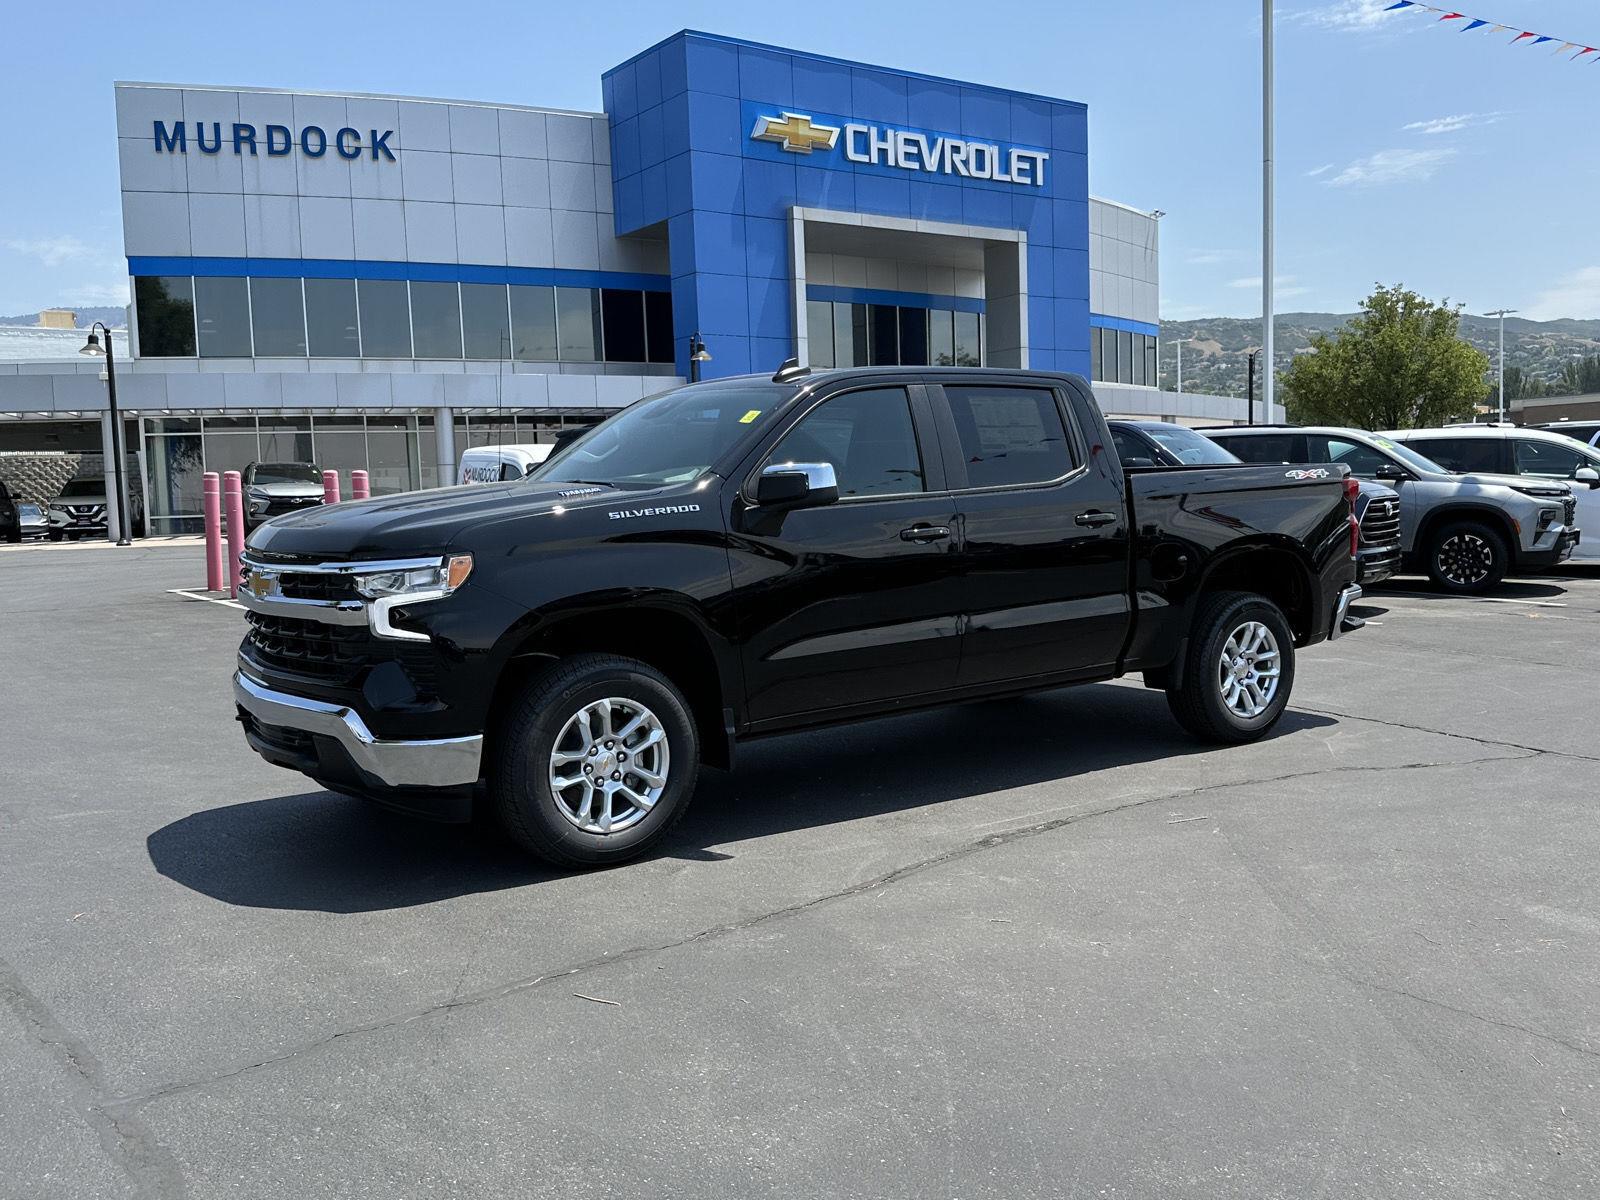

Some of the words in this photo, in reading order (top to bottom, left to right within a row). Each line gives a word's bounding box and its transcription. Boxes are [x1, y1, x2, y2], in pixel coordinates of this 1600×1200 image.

[153, 120, 396, 162] MURDOCK
[844, 123, 1049, 186] CHEVROLET
[608, 504, 700, 520] SILVERADO
